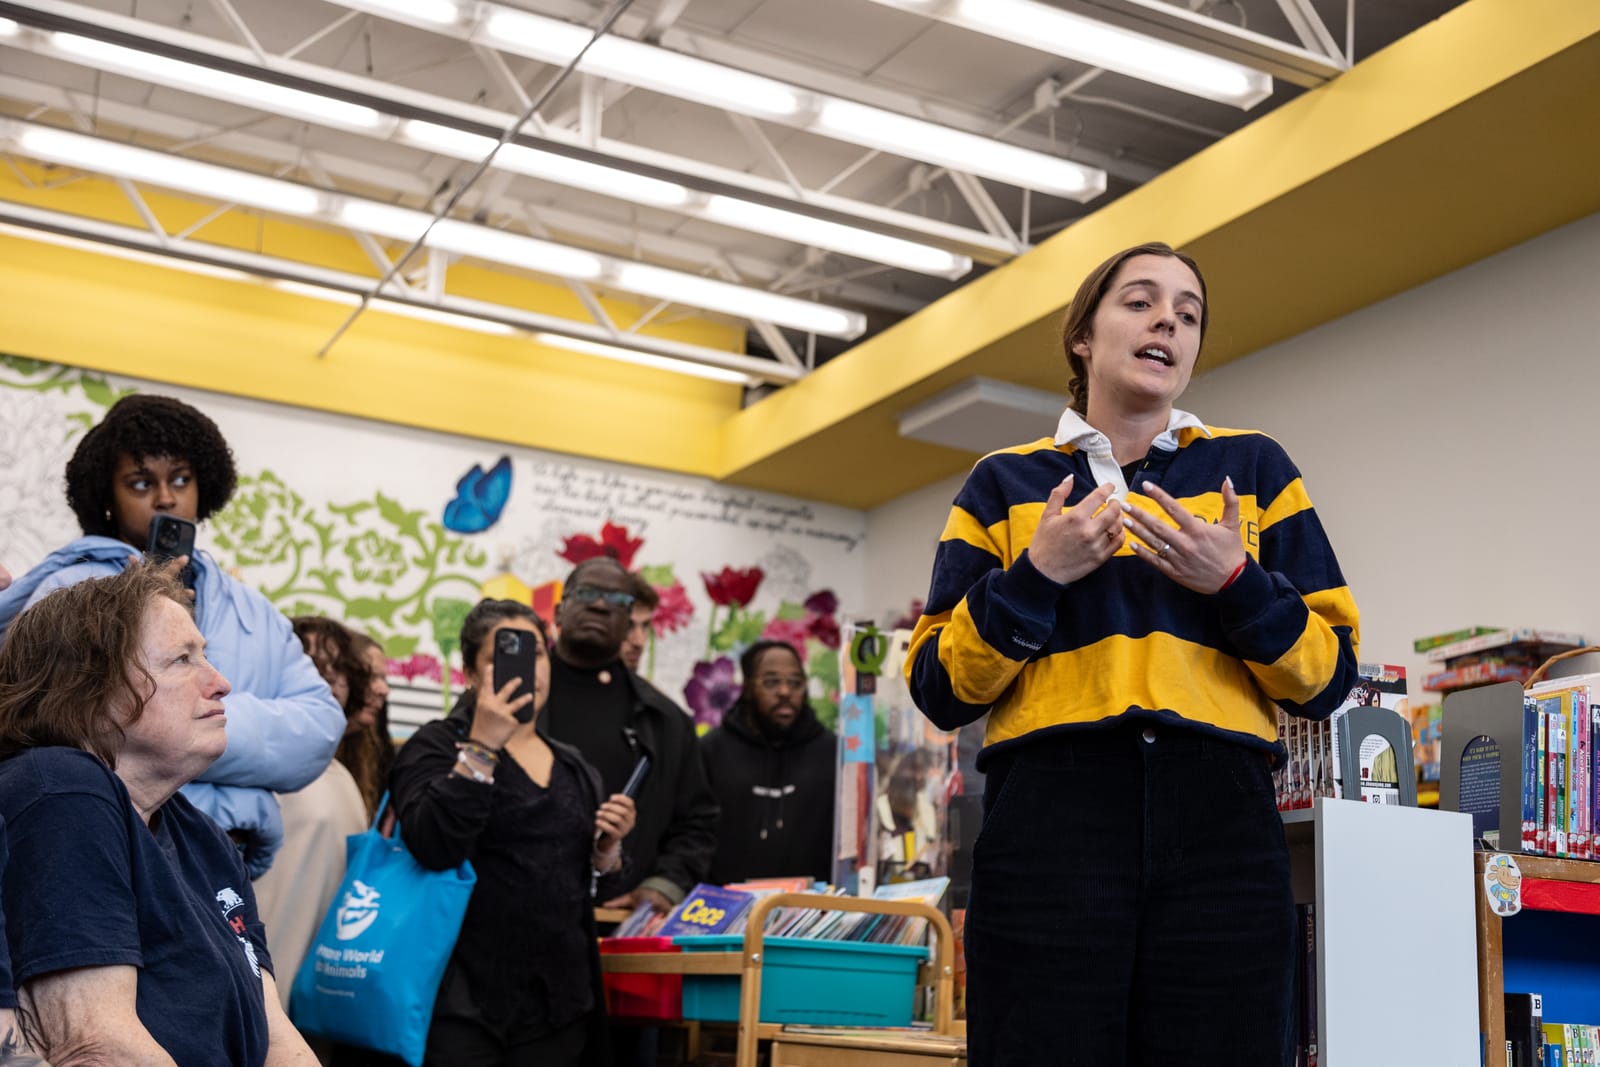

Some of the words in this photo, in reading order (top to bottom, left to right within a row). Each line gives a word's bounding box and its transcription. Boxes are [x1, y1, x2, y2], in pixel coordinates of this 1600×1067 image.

[681, 898, 726, 927] Cece
[343, 948, 385, 964] World
[1535, 999, 1541, 1009] B
